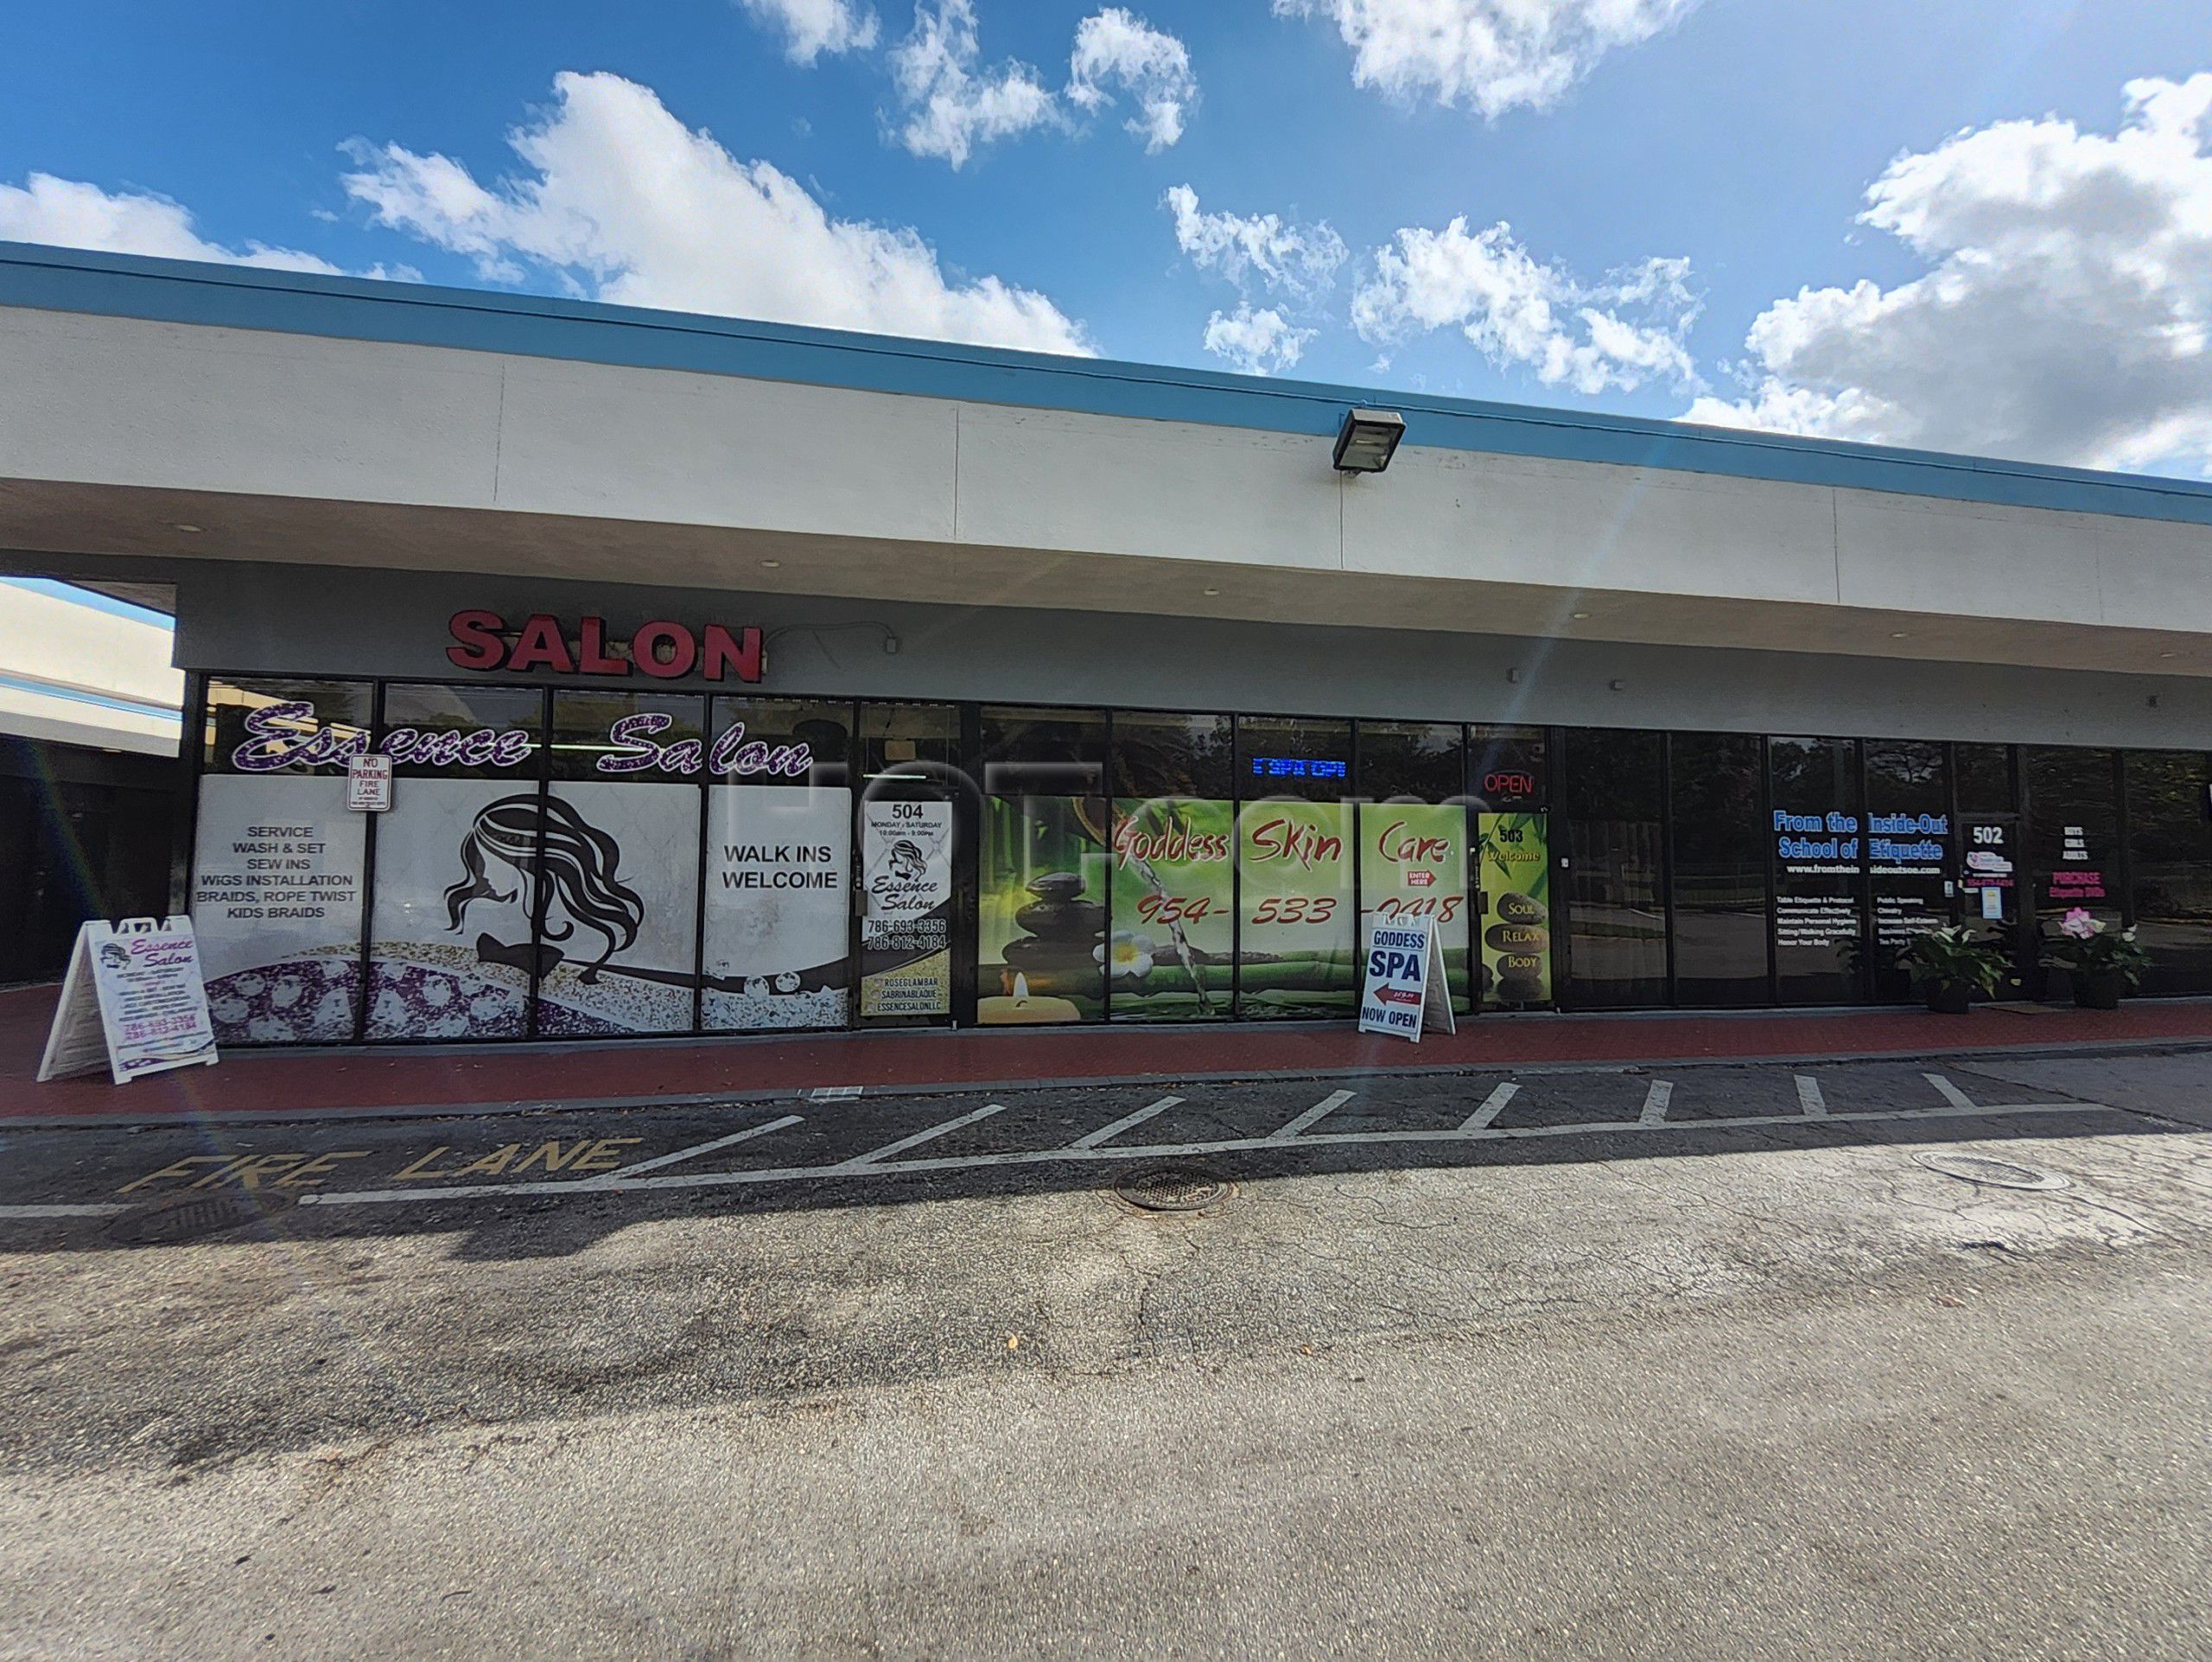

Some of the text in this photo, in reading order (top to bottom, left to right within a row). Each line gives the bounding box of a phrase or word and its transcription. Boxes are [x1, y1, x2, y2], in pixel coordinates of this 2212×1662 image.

[446, 608, 763, 683] SALON
[232, 700, 814, 777] Essence Salon
[363, 758, 378, 768] NO
[352, 768, 388, 780] PARKING
[359, 780, 379, 788] FIRE
[1484, 774, 1533, 794] OPEN
[892, 804, 924, 819] 504
[1773, 810, 1948, 834] From the Inside-Out
[247, 826, 314, 838] SERVICE
[1499, 829, 1523, 843] 503
[1973, 826, 2004, 844] 502
[232, 843, 326, 854] WASH & SET
[1114, 816, 1229, 871] Goddess
[1378, 820, 1450, 863] Care
[1778, 837, 1944, 864] School of Etiquette
[724, 845, 831, 863] WALK INS
[1488, 850, 1541, 862] Welcome
[247, 859, 311, 870] SEW INS
[200, 876, 353, 886] WIGS INSTALLATION
[722, 871, 837, 888] WELCOME
[871, 875, 938, 895] Essence
[196, 891, 357, 903] BRAIDS, ROPE TWIST
[881, 893, 936, 911] Salon
[227, 907, 325, 919] KIDS BRAIDS
[1251, 898, 1338, 925] 533
[868, 919, 947, 933] 786-693-3356
[130, 939, 194, 955] Essence
[868, 934, 947, 950] 786-812-4184
[1374, 931, 1425, 949] GODDESS
[143, 952, 194, 968] Salon
[1369, 951, 1421, 982] SPA
[1362, 1007, 1417, 1028] NOW OPEN
[391, 1137, 644, 1181] LANE
